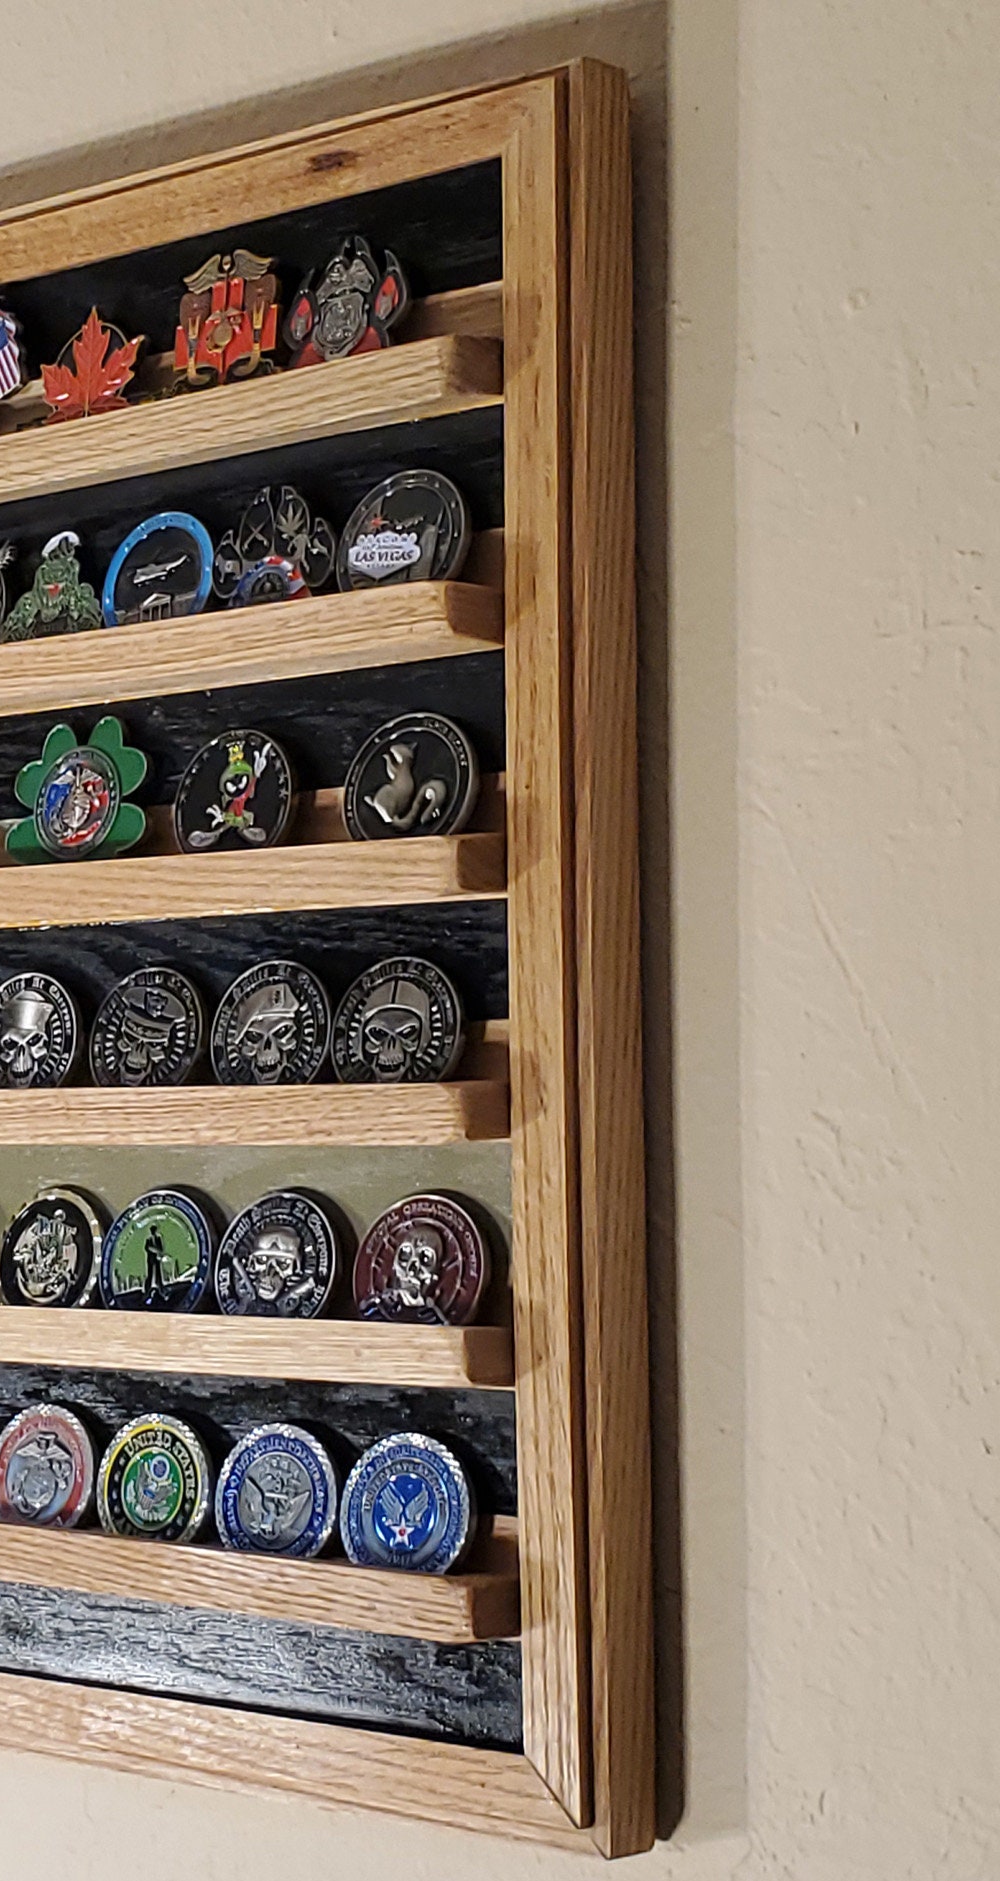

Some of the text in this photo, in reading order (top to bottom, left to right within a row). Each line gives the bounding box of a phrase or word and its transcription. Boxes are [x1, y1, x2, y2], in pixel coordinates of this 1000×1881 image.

[355, 550, 415, 562] LAS VEGAS
[123, 1430, 172, 1458] UNITED
[172, 1441, 197, 1501] STATES
